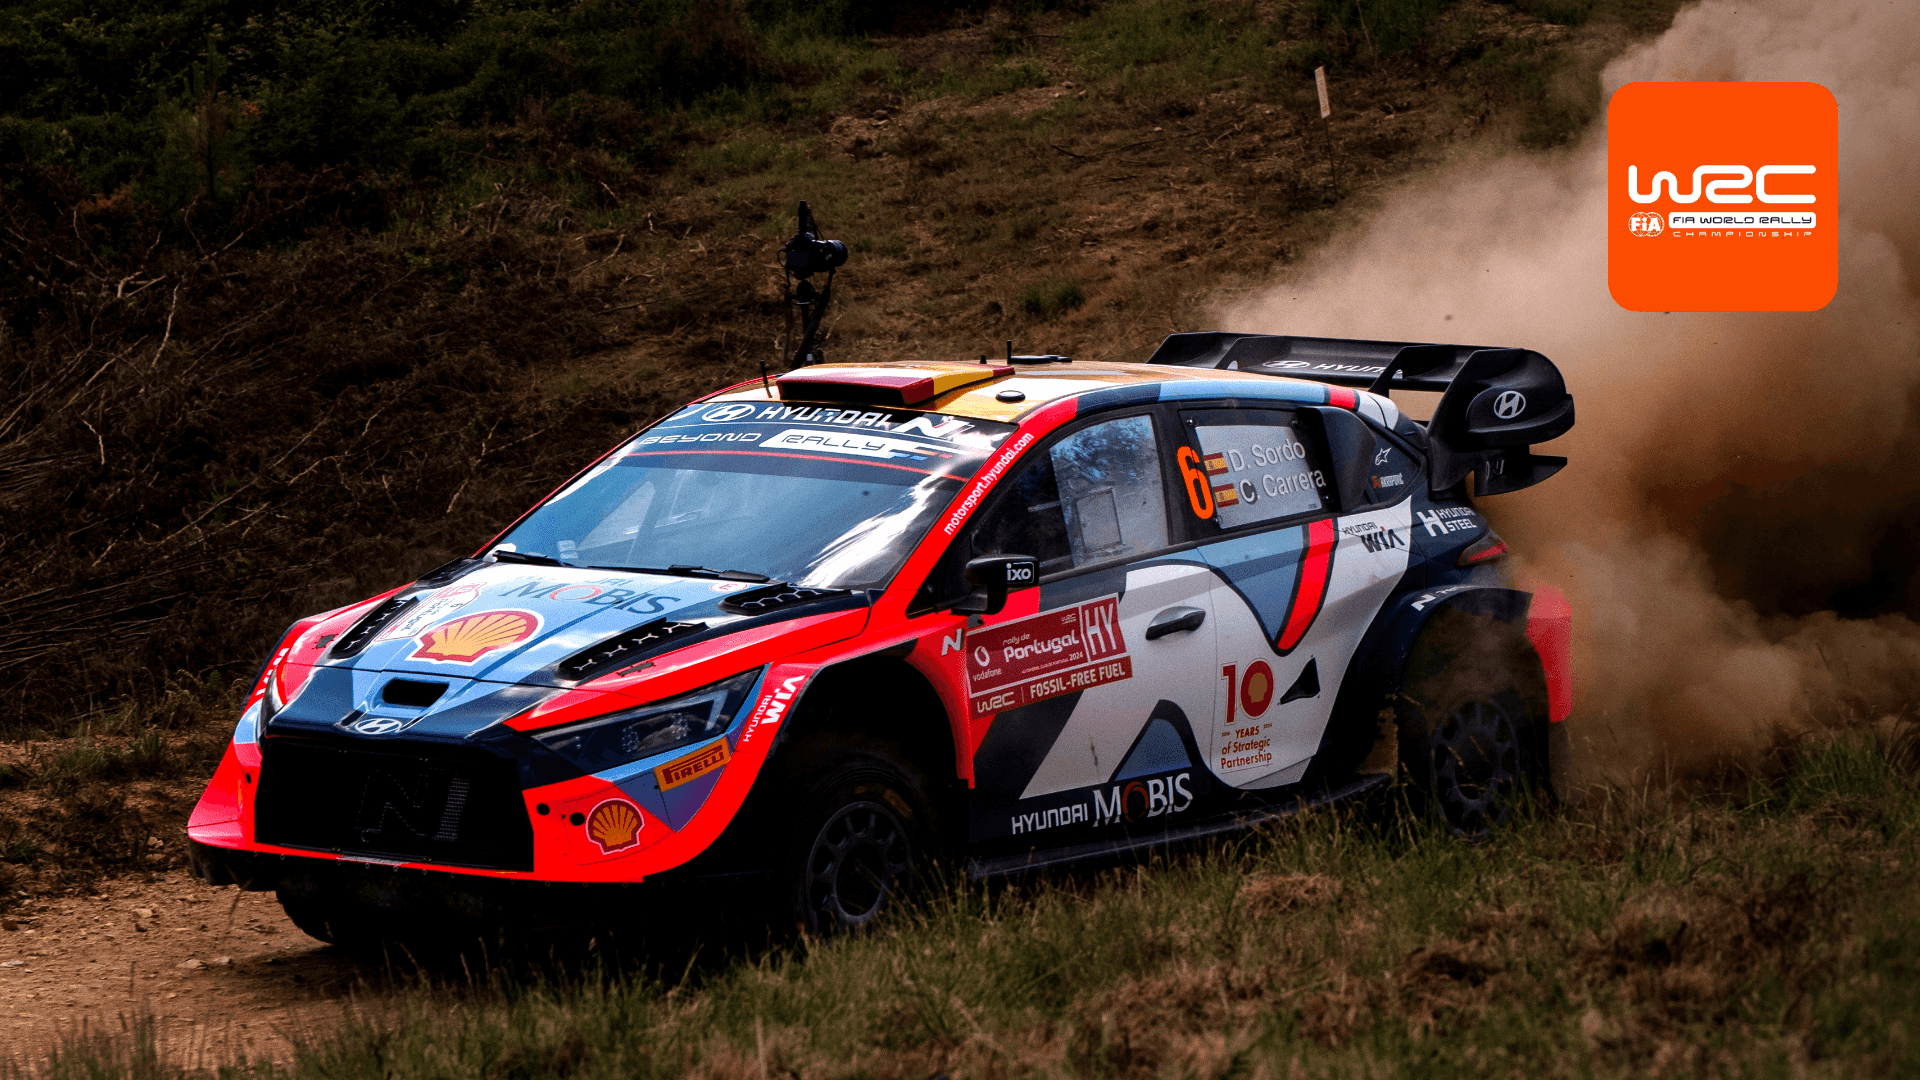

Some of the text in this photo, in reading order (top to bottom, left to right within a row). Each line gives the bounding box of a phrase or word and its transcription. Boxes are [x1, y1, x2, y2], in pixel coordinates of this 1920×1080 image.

[755, 405, 893, 428] HYUNDAI
[639, 432, 762, 445] BEYOND
[781, 434, 886, 451] RALLY
[1227, 438, 1306, 473] D. Sordo
[943, 432, 1034, 535] motorsport.hyundai.com
[1177, 446, 1214, 519] 6
[1239, 470, 1327, 504] C. Carrera
[1435, 506, 1476, 519] HYUNDAI
[1445, 518, 1478, 532] STEEL
[1341, 521, 1378, 535] HYUNDAI
[1361, 526, 1405, 553] WIA
[1006, 563, 1032, 581] ixo
[497, 582, 682, 614] MOBIS
[941, 628, 964, 656] N
[1003, 633, 1031, 645] rally de
[1085, 603, 1117, 655] HY
[1003, 630, 1080, 662] Portugal
[1069, 651, 1084, 662] 2024
[972, 667, 1002, 682] vodafone
[1030, 662, 1126, 699] FOSSIL-FREE FUEL
[760, 675, 806, 724] WIA
[976, 691, 1015, 714] WRC
[1221, 659, 1274, 725] 10
[743, 695, 773, 742] HYUNDAI
[1221, 735, 1271, 755] of Strategic
[1235, 726, 1260, 739] YEARS
[662, 745, 725, 784] PIRELLI
[1221, 749, 1272, 769] Partnership
[1011, 772, 1194, 835] HYUNDAI MOBIS
